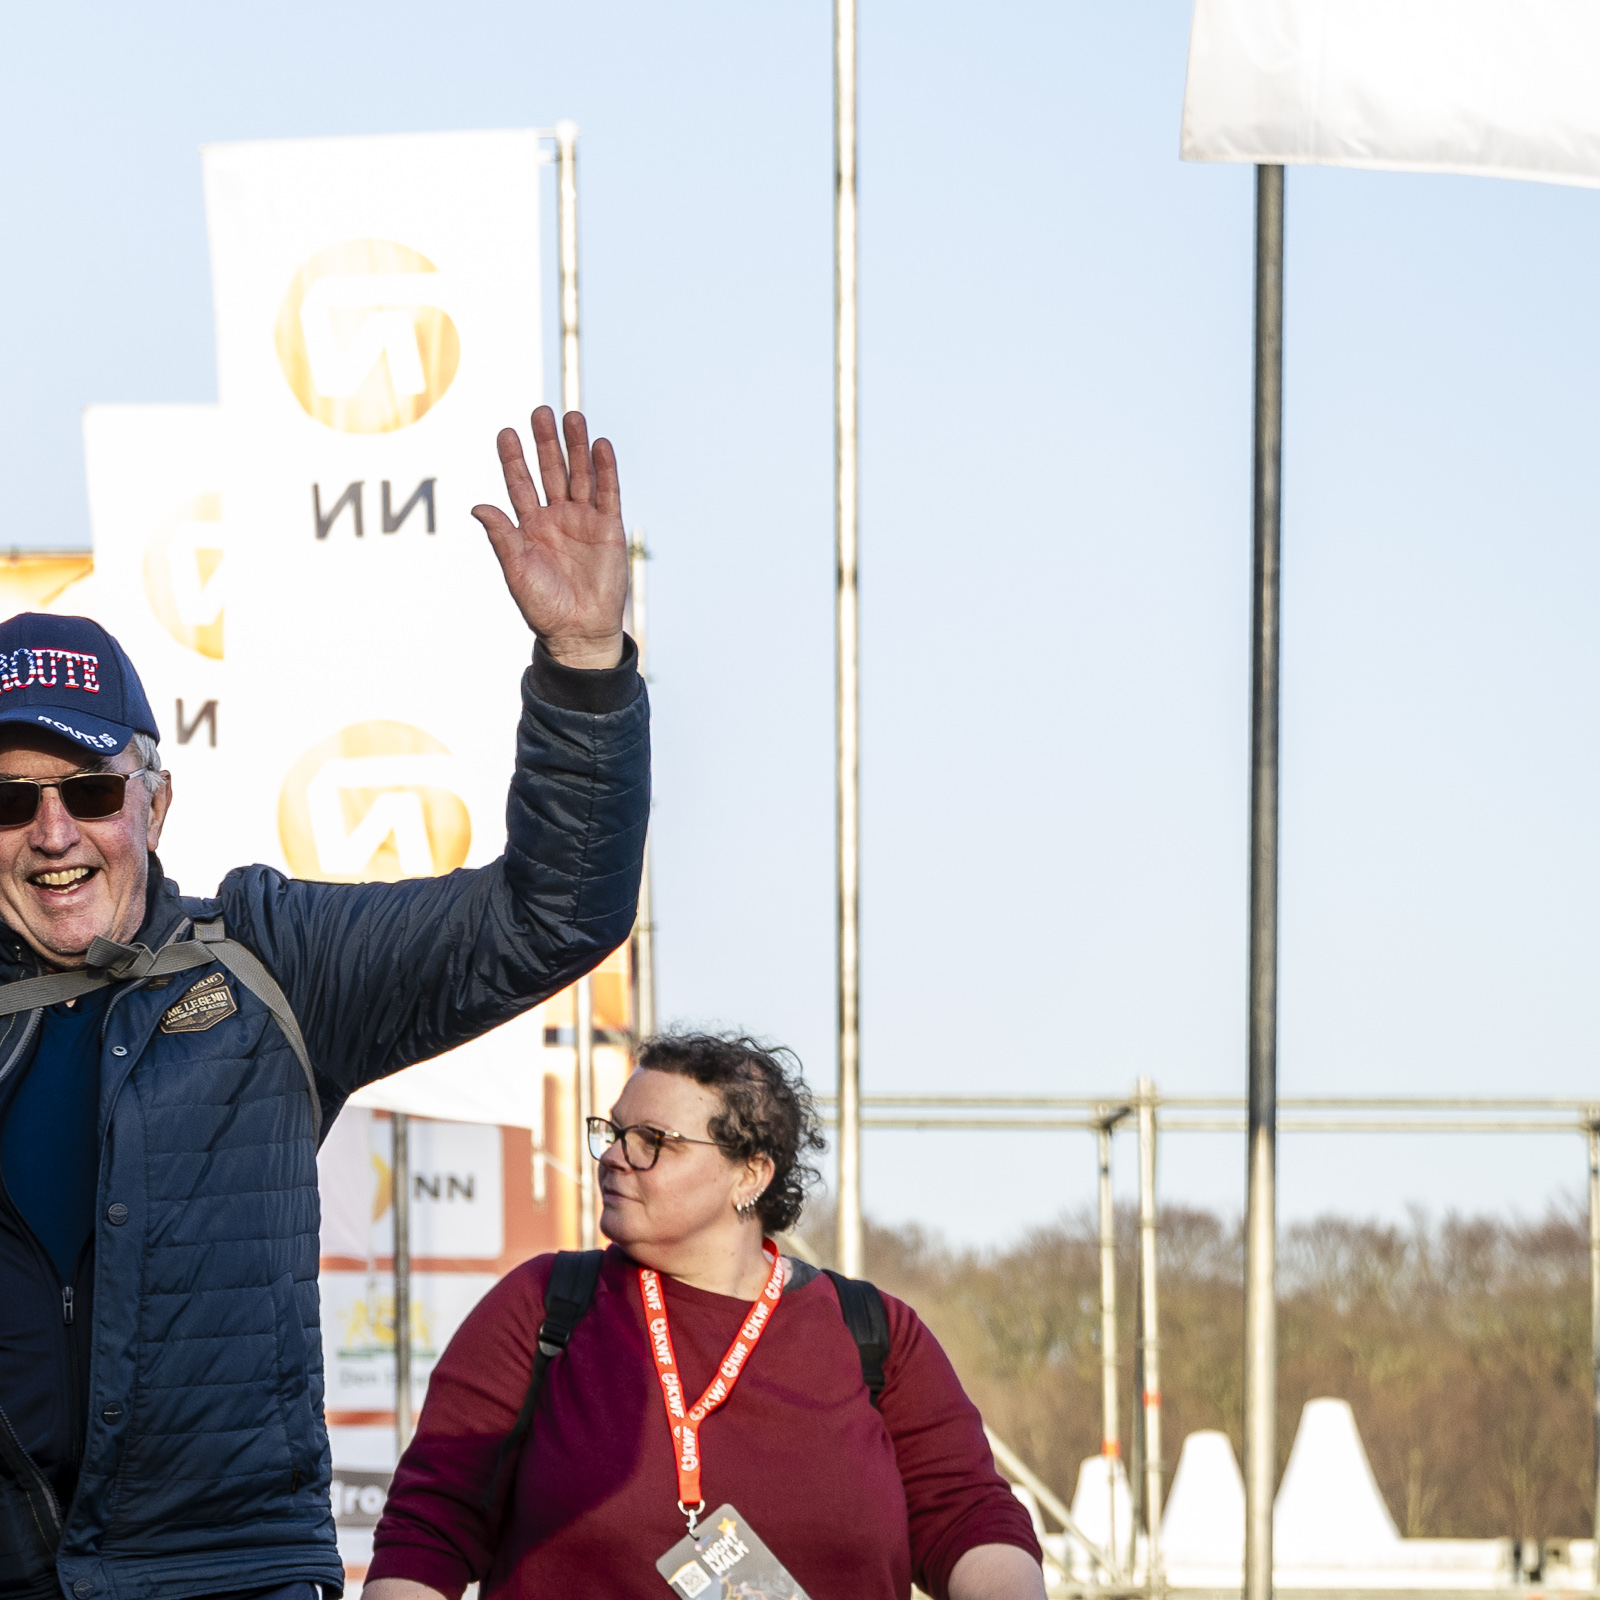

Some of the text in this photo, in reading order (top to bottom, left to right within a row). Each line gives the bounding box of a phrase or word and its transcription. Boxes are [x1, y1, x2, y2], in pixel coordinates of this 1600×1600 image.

[38, 715, 118, 748] ROUTE 66
[183, 991, 228, 1011] LEGEND
[644, 1278, 662, 1311] KWF
[654, 1333, 672, 1365] KWF
[666, 1384, 685, 1419] KWF
[702, 1378, 728, 1411] KWF
